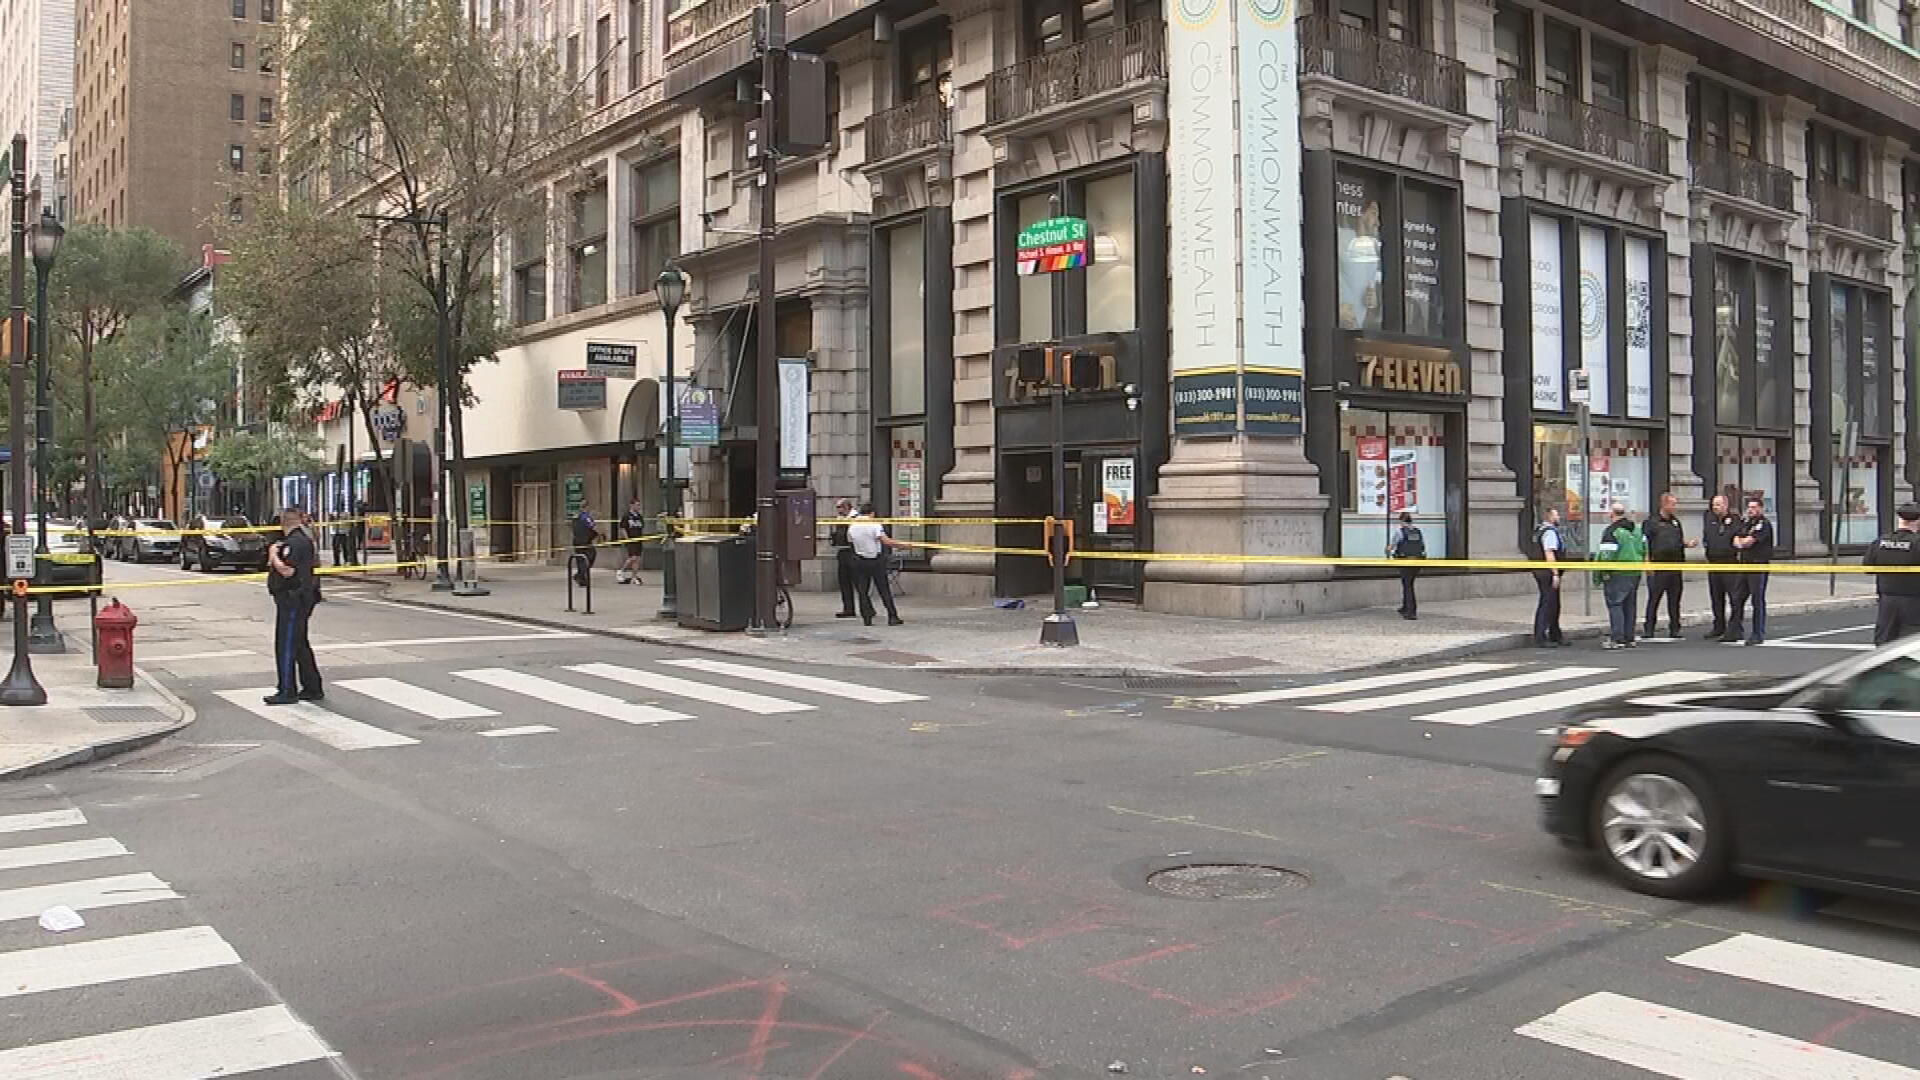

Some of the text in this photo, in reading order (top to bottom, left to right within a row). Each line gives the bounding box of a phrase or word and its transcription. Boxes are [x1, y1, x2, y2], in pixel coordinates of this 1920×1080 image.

[1190, 41, 1215, 347] COMMONWEALTH
[1259, 40, 1283, 347] COMMONWEALTH
[1018, 226, 1068, 247] Chestnut
[1072, 223, 1085, 239] St
[1106, 465, 1132, 481] FREE
[1880, 541, 1911, 551] POLICE
